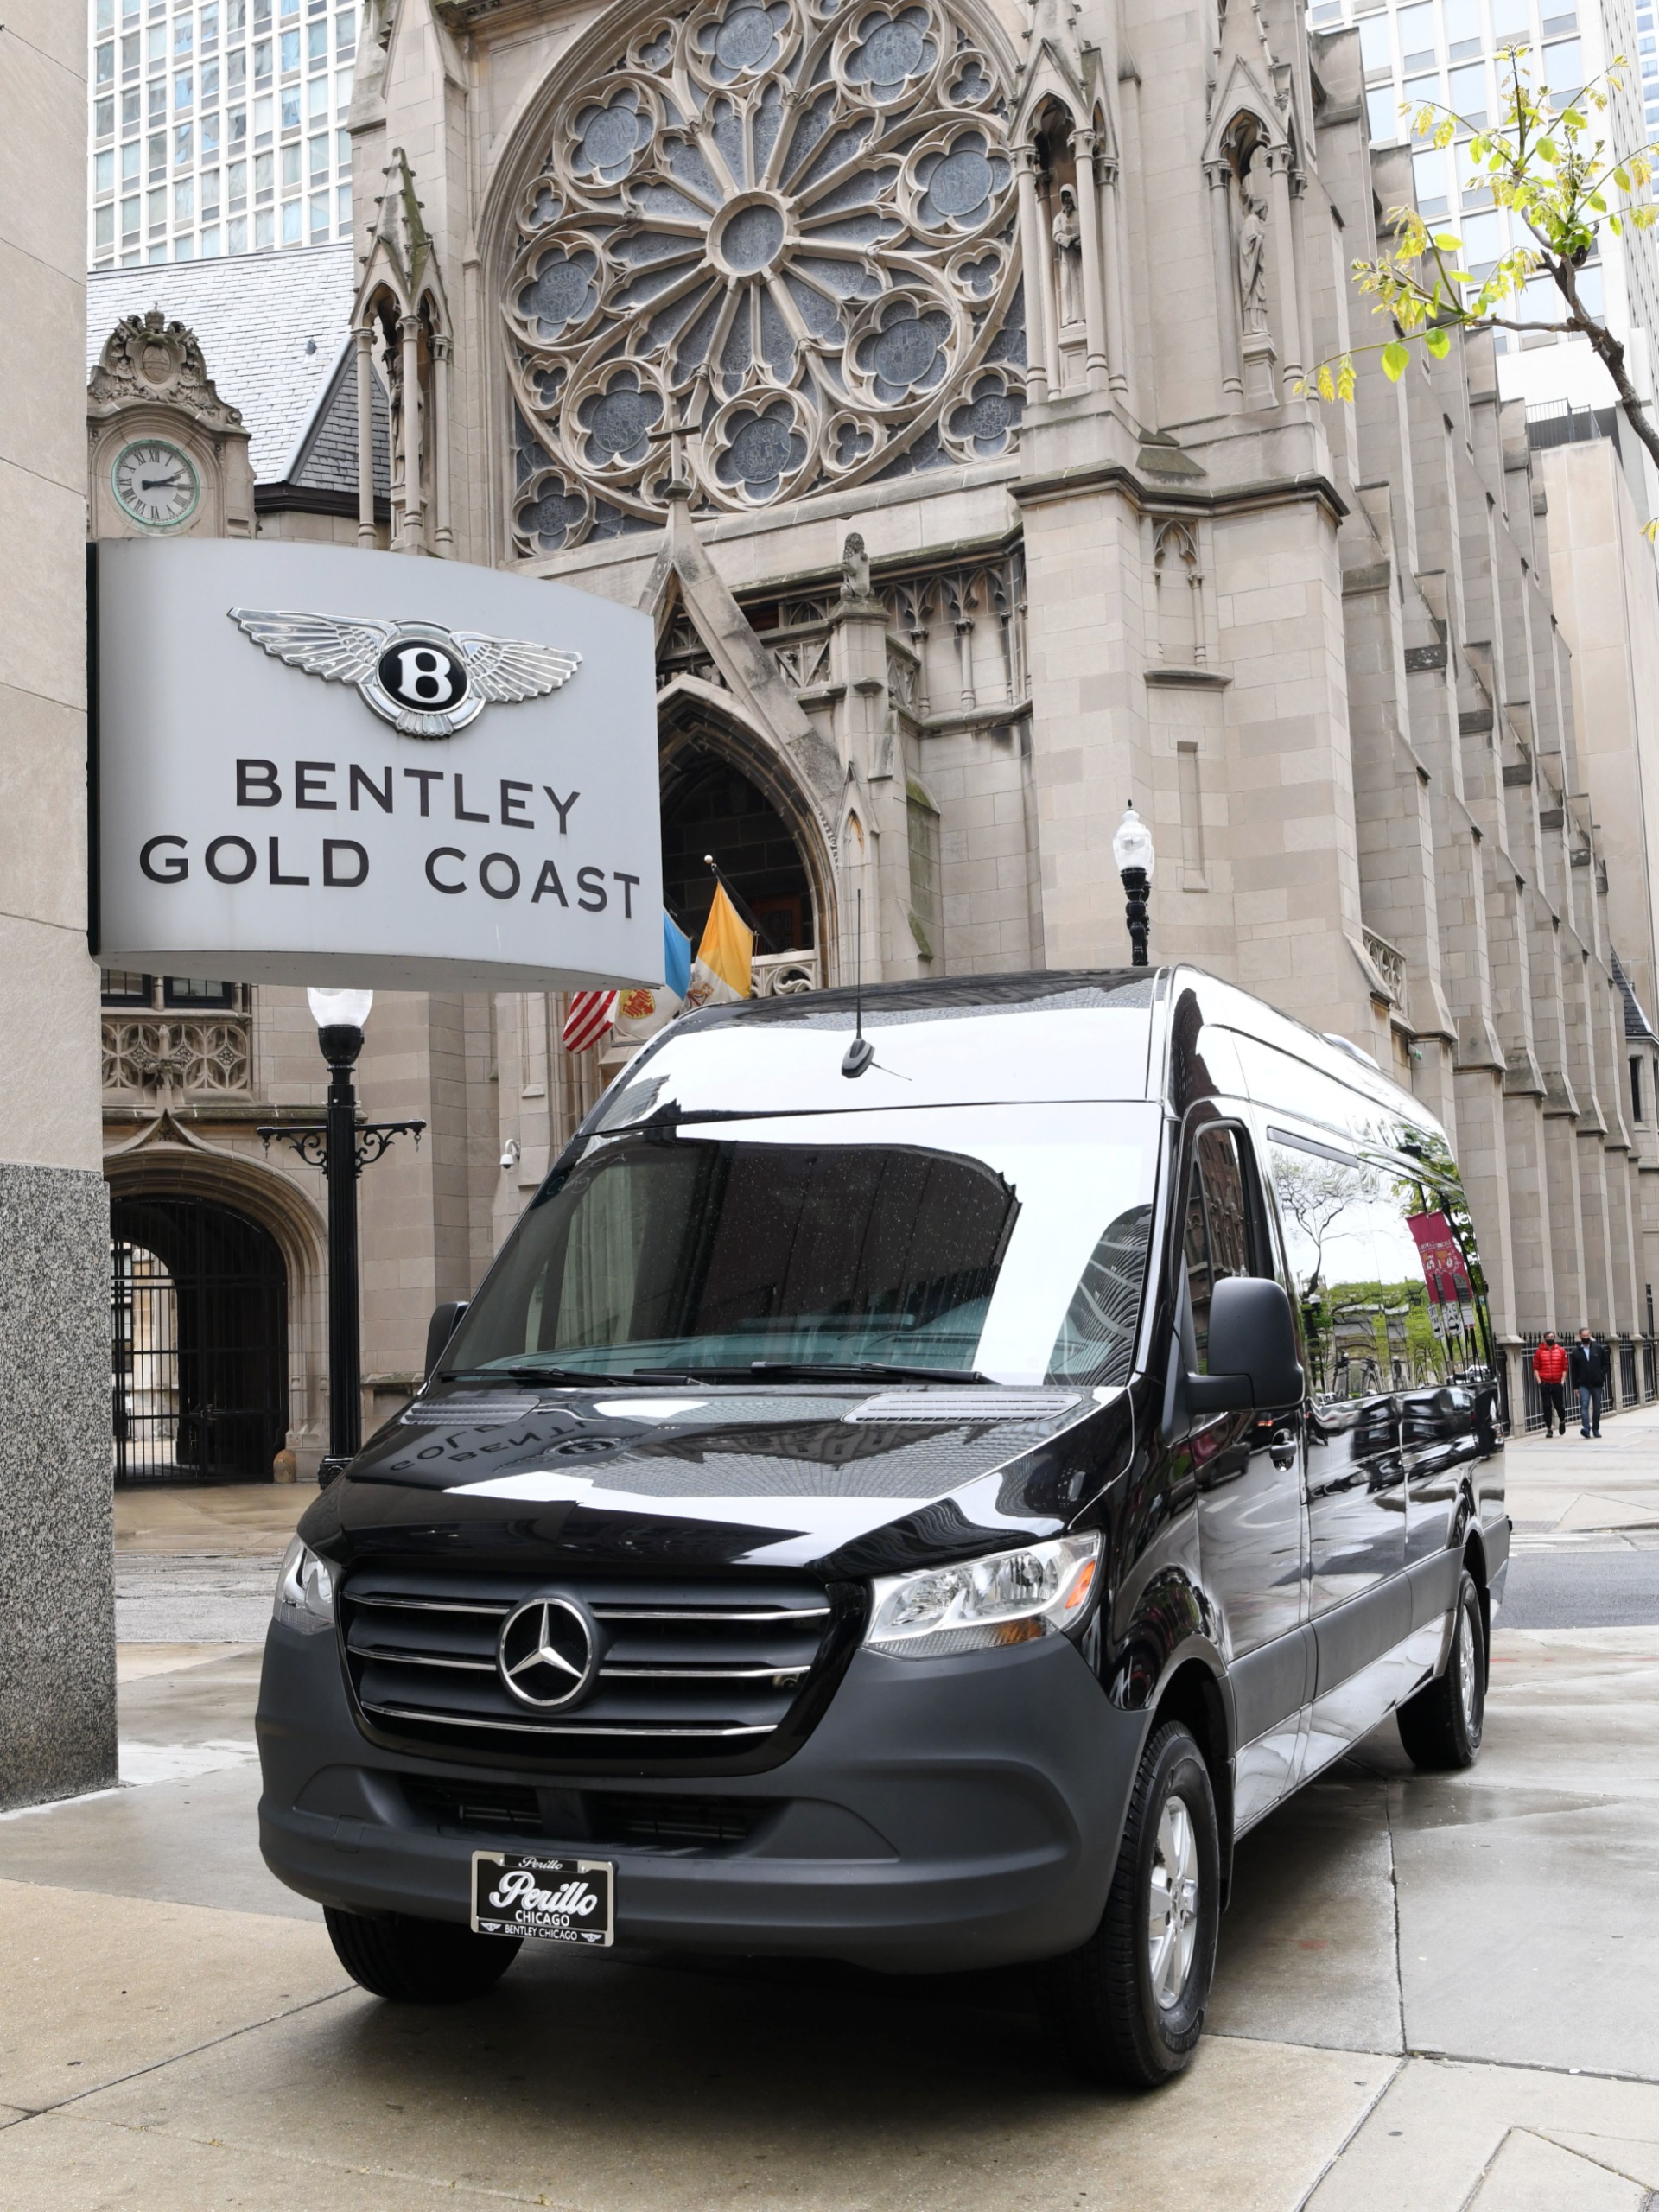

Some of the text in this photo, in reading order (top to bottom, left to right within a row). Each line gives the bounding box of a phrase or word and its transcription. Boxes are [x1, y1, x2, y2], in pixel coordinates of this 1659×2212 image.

[148, 449, 161, 463] XII
[397, 647, 453, 704] B
[236, 758, 581, 835] BENTLEY
[139, 834, 640, 918] GOLD COAST
[518, 1856, 563, 1870] Perillo
[489, 1871, 598, 1916] Perillo
[505, 1923, 578, 1941] BENTLEY CHICAGO
[515, 1910, 570, 1927] CHICAGO
